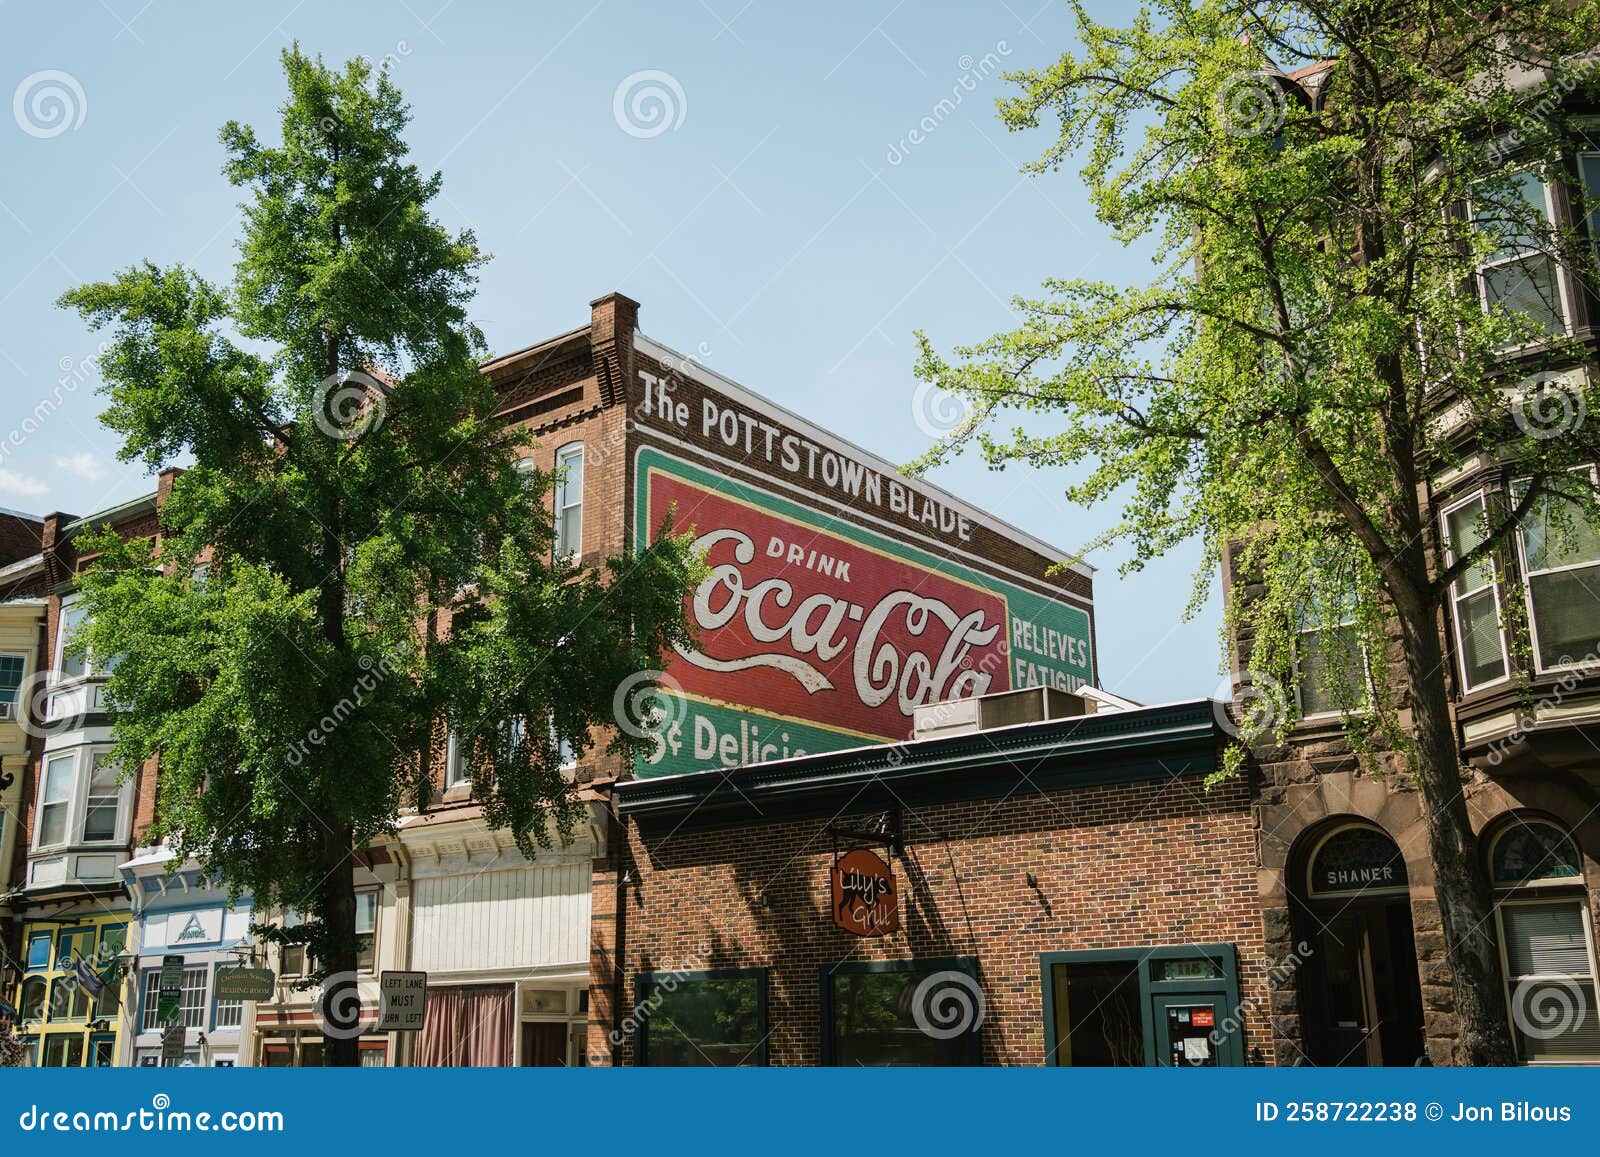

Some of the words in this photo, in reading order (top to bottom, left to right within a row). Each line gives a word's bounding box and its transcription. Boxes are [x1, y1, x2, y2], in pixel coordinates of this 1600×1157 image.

[638, 370, 690, 427] The
[702, 398, 882, 506] POTTSTOWN
[889, 486, 971, 542] BLADE
[766, 536, 851, 583] DRINK
[676, 529, 1000, 717] Coca-Cola
[1012, 616, 1087, 668] RELIEVES
[694, 714, 808, 768] Delici
[839, 867, 888, 905] Lily's
[1327, 866, 1393, 885] SHANER
[852, 901, 891, 930] Grill
[384, 978, 402, 989] LEFT
[405, 978, 424, 989] LANE
[390, 994, 415, 1007] MUST
[382, 1012, 400, 1023] URN
[405, 1013, 422, 1023] LEFT
